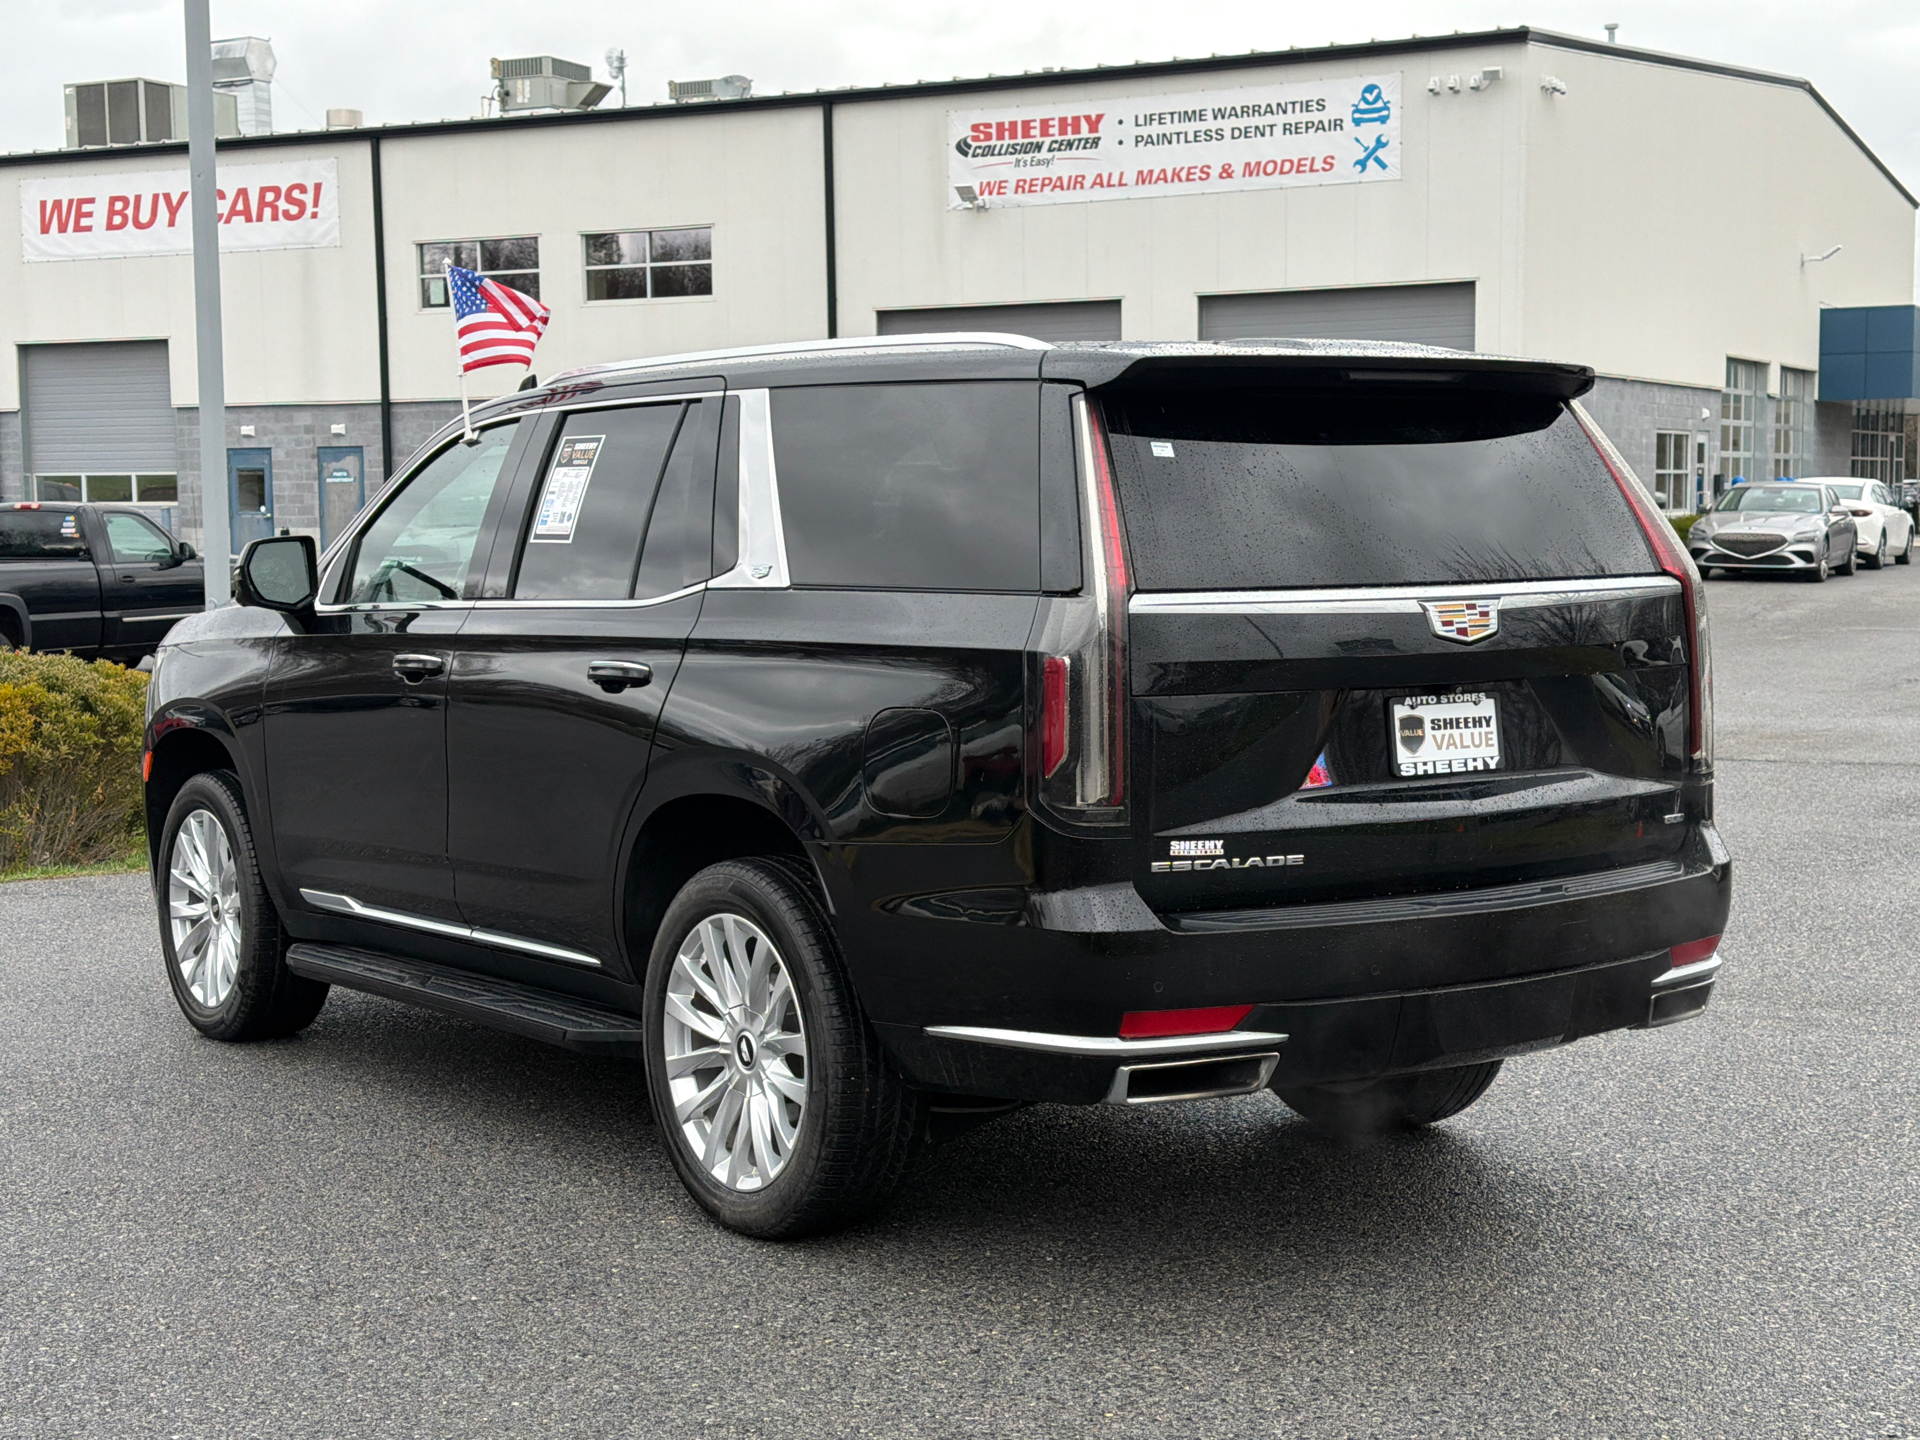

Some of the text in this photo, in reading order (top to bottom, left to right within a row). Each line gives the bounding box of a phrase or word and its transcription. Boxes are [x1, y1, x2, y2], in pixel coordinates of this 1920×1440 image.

[1134, 98, 1326, 127] LIFETIME WARRANTIES
[970, 113, 1105, 142] SHEEHY
[1134, 118, 1344, 148] PAINTLESS DENT REPAIR
[970, 137, 1102, 158] COLLISION CENTER
[1013, 154, 1055, 169] It's Easy!
[978, 154, 1336, 197] WE REPAIR ALL MAKES & MODELS
[39, 196, 96, 235] WE
[105, 190, 190, 232] BUY
[1404, 692, 1487, 706] AUTO STORES
[1430, 716, 1493, 731] SHEEHY
[1431, 731, 1495, 751] VALUE
[1400, 756, 1500, 776] SHEEHY
[1170, 840, 1223, 850] SHEEHY
[1150, 854, 1305, 873] ESCALADE
